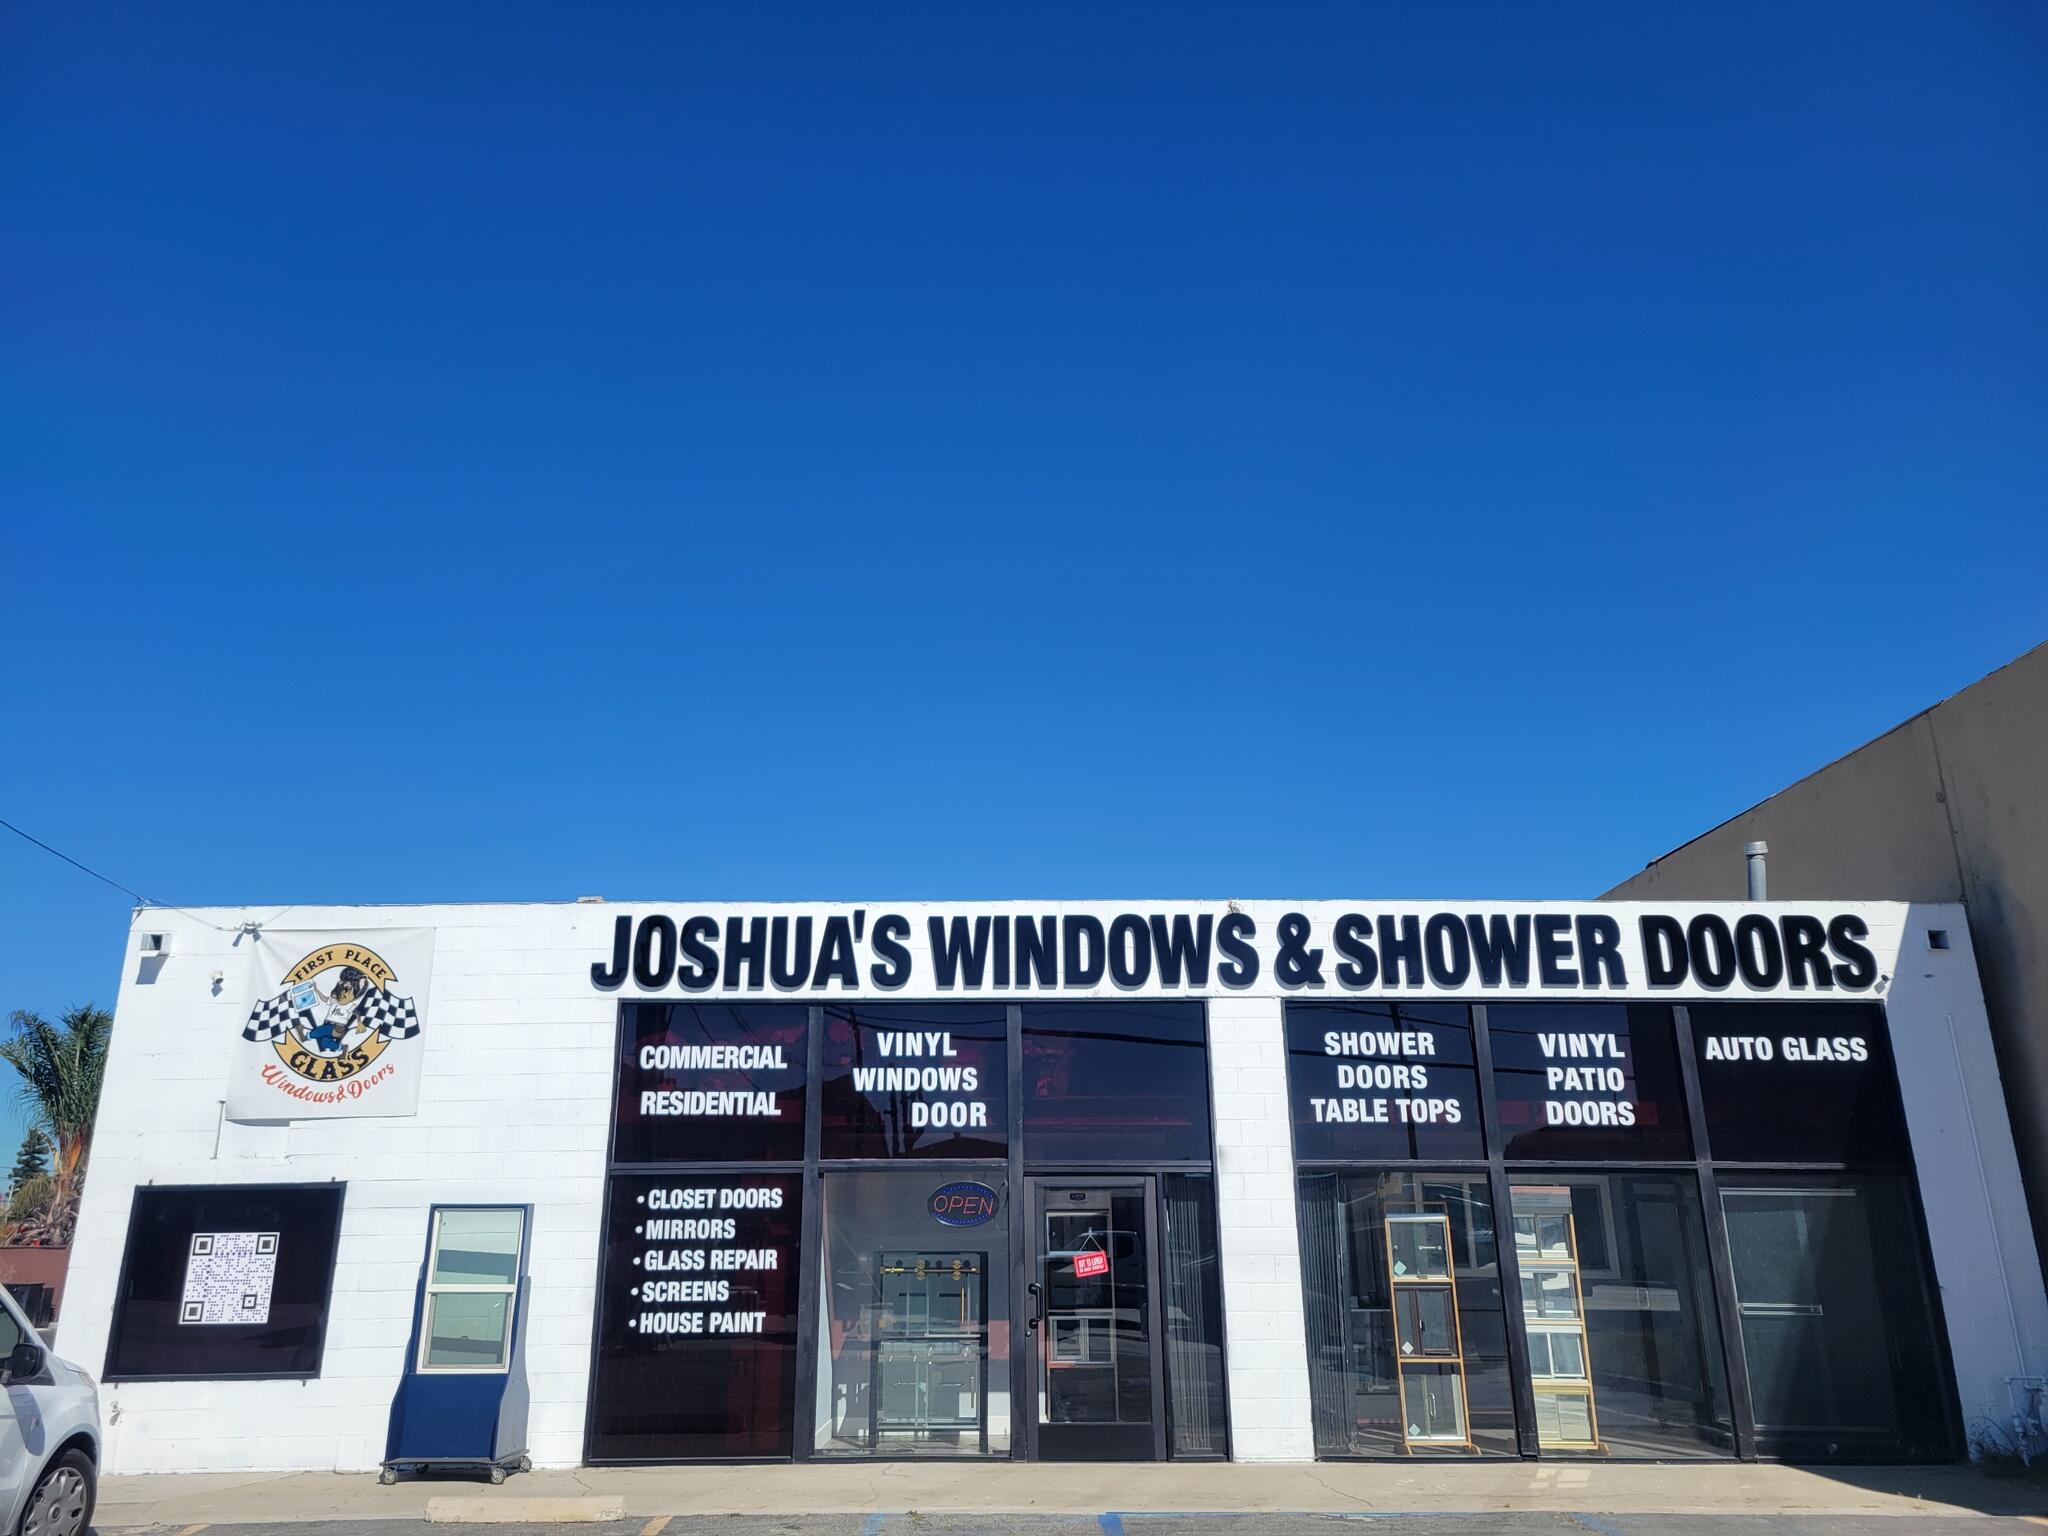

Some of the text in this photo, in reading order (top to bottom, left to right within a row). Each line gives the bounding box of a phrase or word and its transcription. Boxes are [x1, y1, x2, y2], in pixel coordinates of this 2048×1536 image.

[590, 909, 1879, 993] JOSHUA'S WINDOWS & SHOWER DOORS
[294, 949, 388, 981] FIRST PLACE
[876, 1032, 959, 1058] VINYL
[1324, 1031, 1437, 1057] SHOWER
[1537, 1033, 1627, 1059] VINYL
[1705, 1036, 1869, 1063] AUTO GLASS
[289, 1046, 370, 1080] GLASS
[639, 1044, 789, 1071] COMMERCIAL
[852, 1066, 979, 1093] WINDOWS
[1337, 1064, 1429, 1090] DOORS
[1546, 1066, 1626, 1092] PATIO
[640, 1090, 782, 1117] RESIDENTIAL
[910, 1101, 988, 1128] DOOR
[1310, 1098, 1463, 1125] TABLE TOPS
[1544, 1100, 1637, 1126] DOORS
[647, 1187, 783, 1210] CLOSET DOORS
[933, 1194, 994, 1216] OPEN
[645, 1218, 736, 1241] MIRRORS
[643, 1249, 778, 1272] GLASS REPAIR
[641, 1280, 730, 1303] SCREENS
[639, 1311, 767, 1334] HOUSE PAINT
